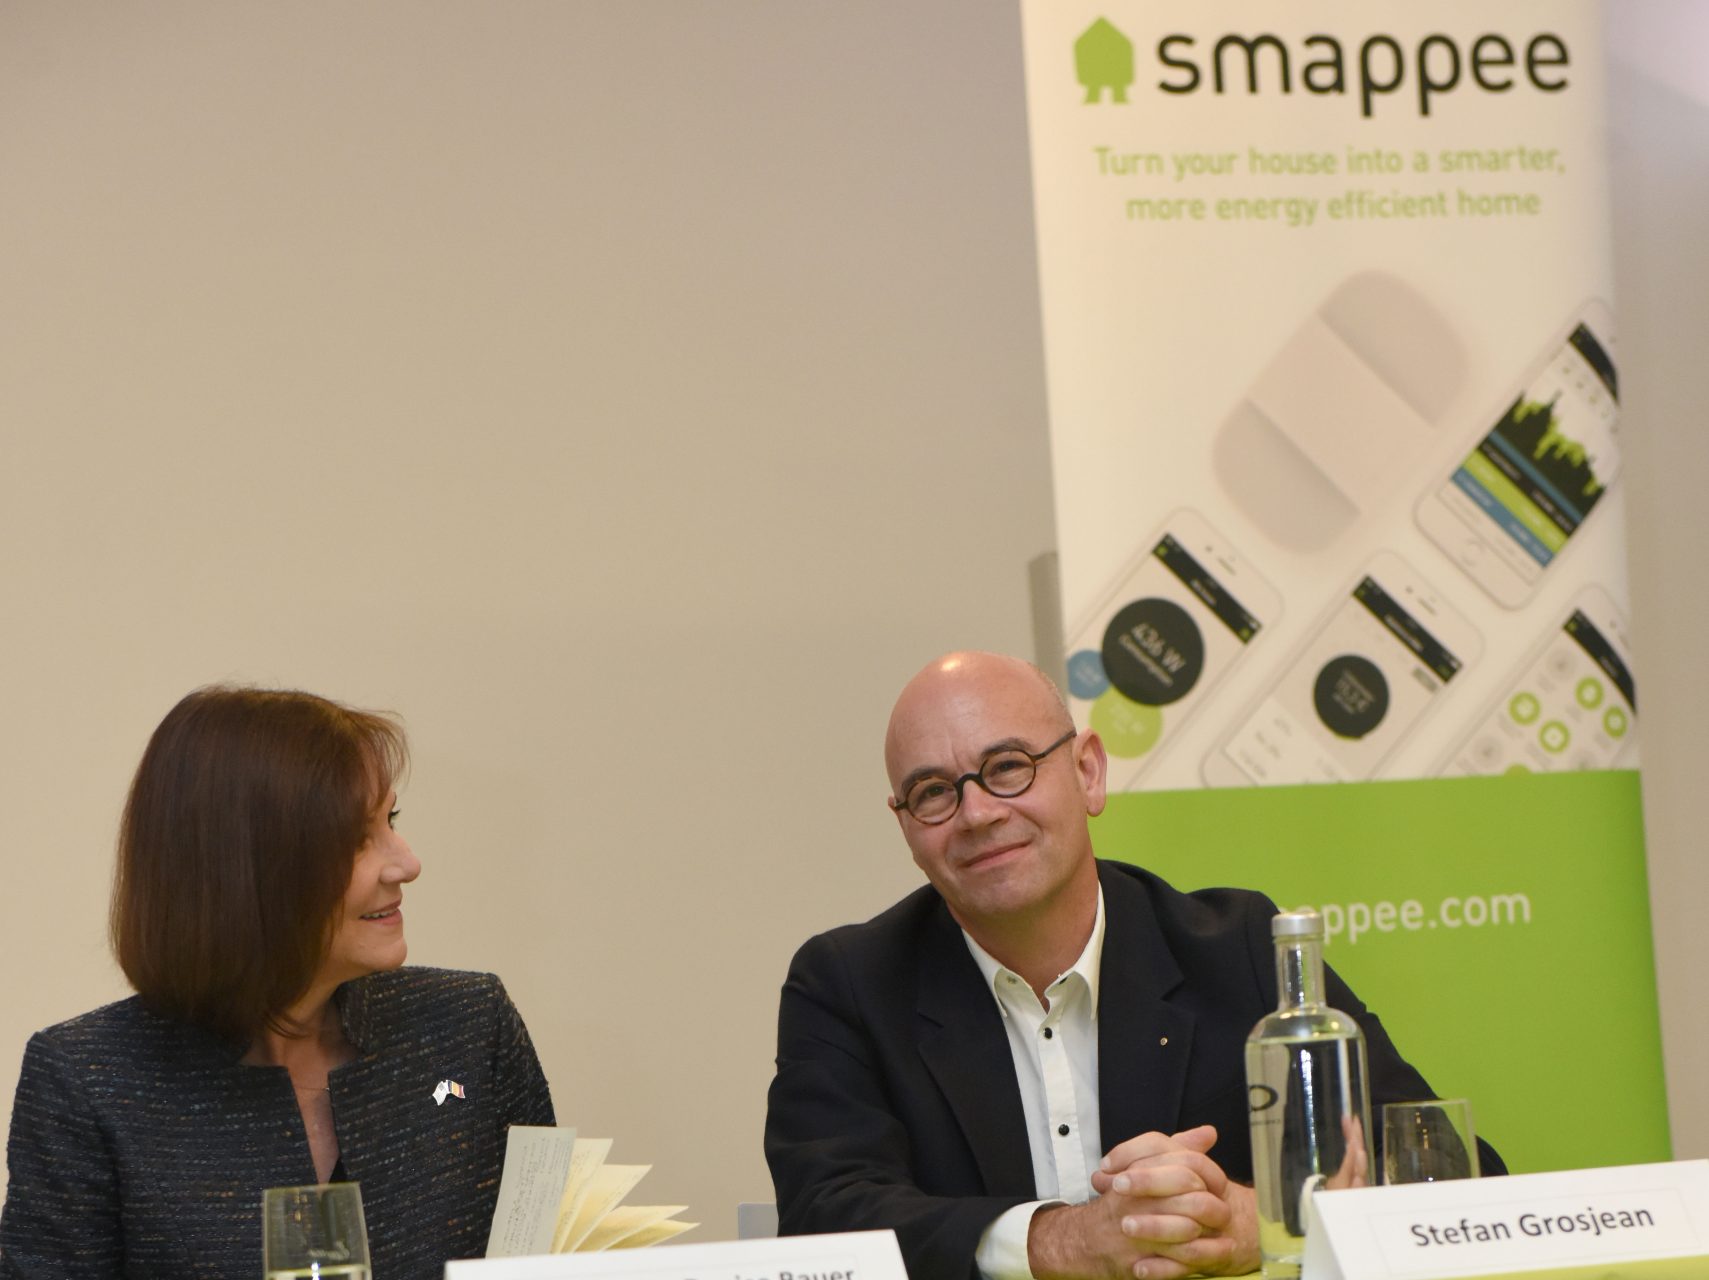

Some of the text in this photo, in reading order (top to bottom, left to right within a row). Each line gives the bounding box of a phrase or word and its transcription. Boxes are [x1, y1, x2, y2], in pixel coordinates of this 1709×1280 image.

[1157, 33, 1571, 117] smappee
[1094, 143, 1568, 182] Turn your house into a smarter,
[1126, 187, 1542, 227] more energy efficient home
[1411, 1206, 1656, 1247] Stefan Grosjean
